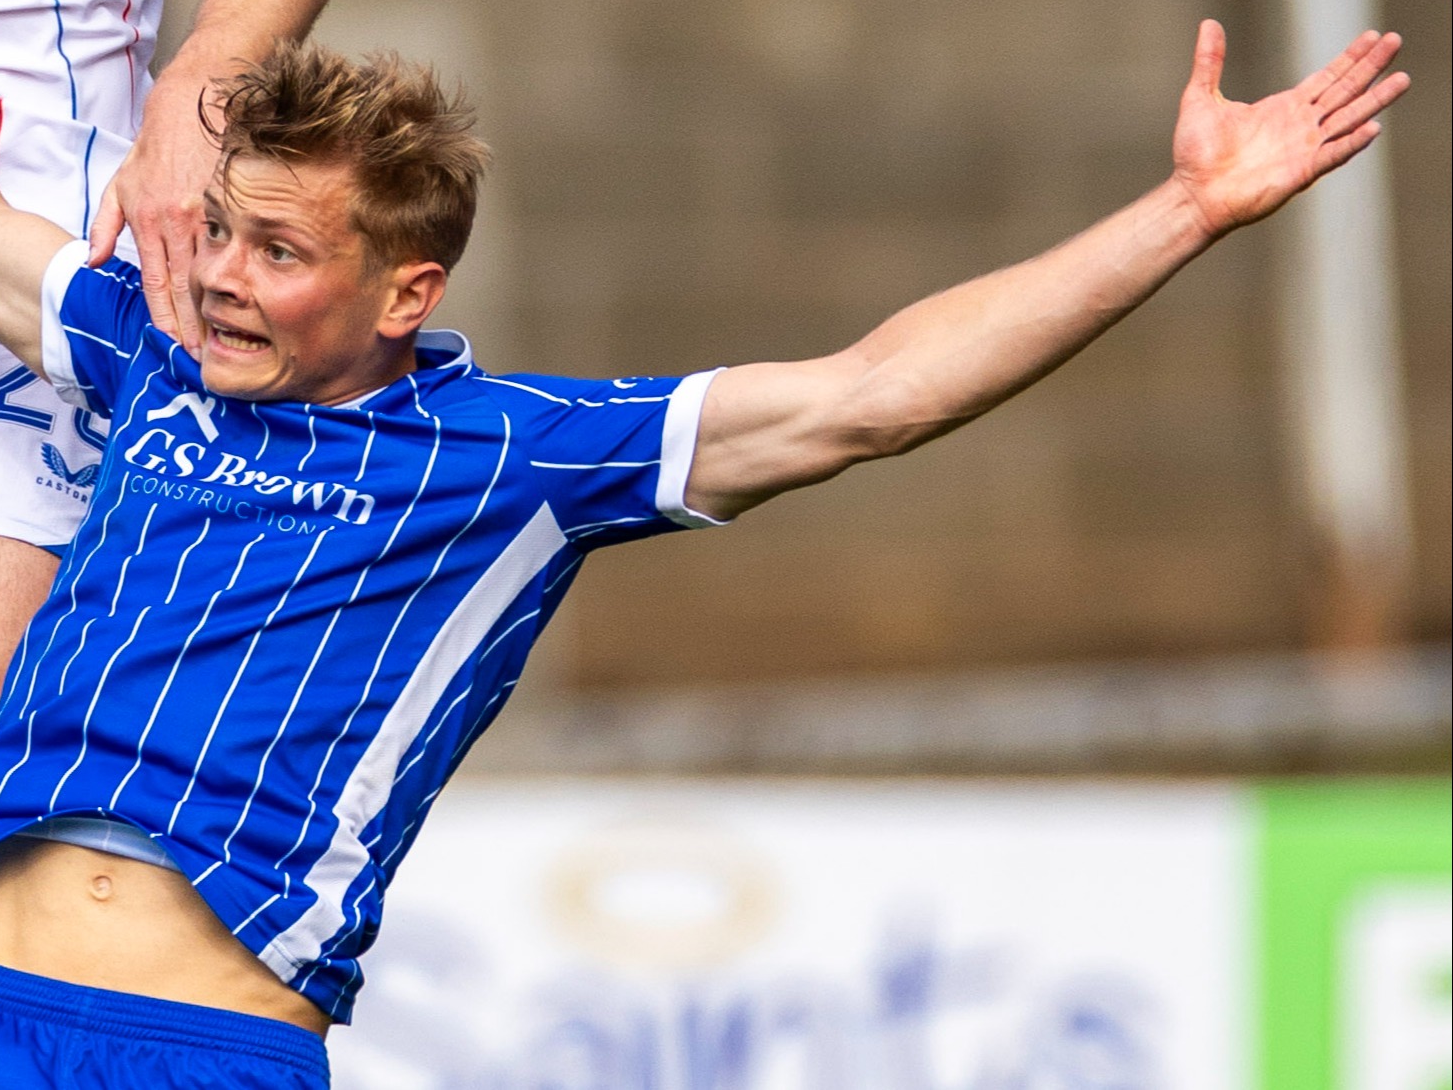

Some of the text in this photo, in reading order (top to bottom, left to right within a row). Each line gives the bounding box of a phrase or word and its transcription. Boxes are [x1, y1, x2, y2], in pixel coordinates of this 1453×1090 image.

[36, 476, 88, 504] CASTOR
[124, 428, 376, 525] GS Brown
[130, 474, 316, 534] CONSTRUCTION
